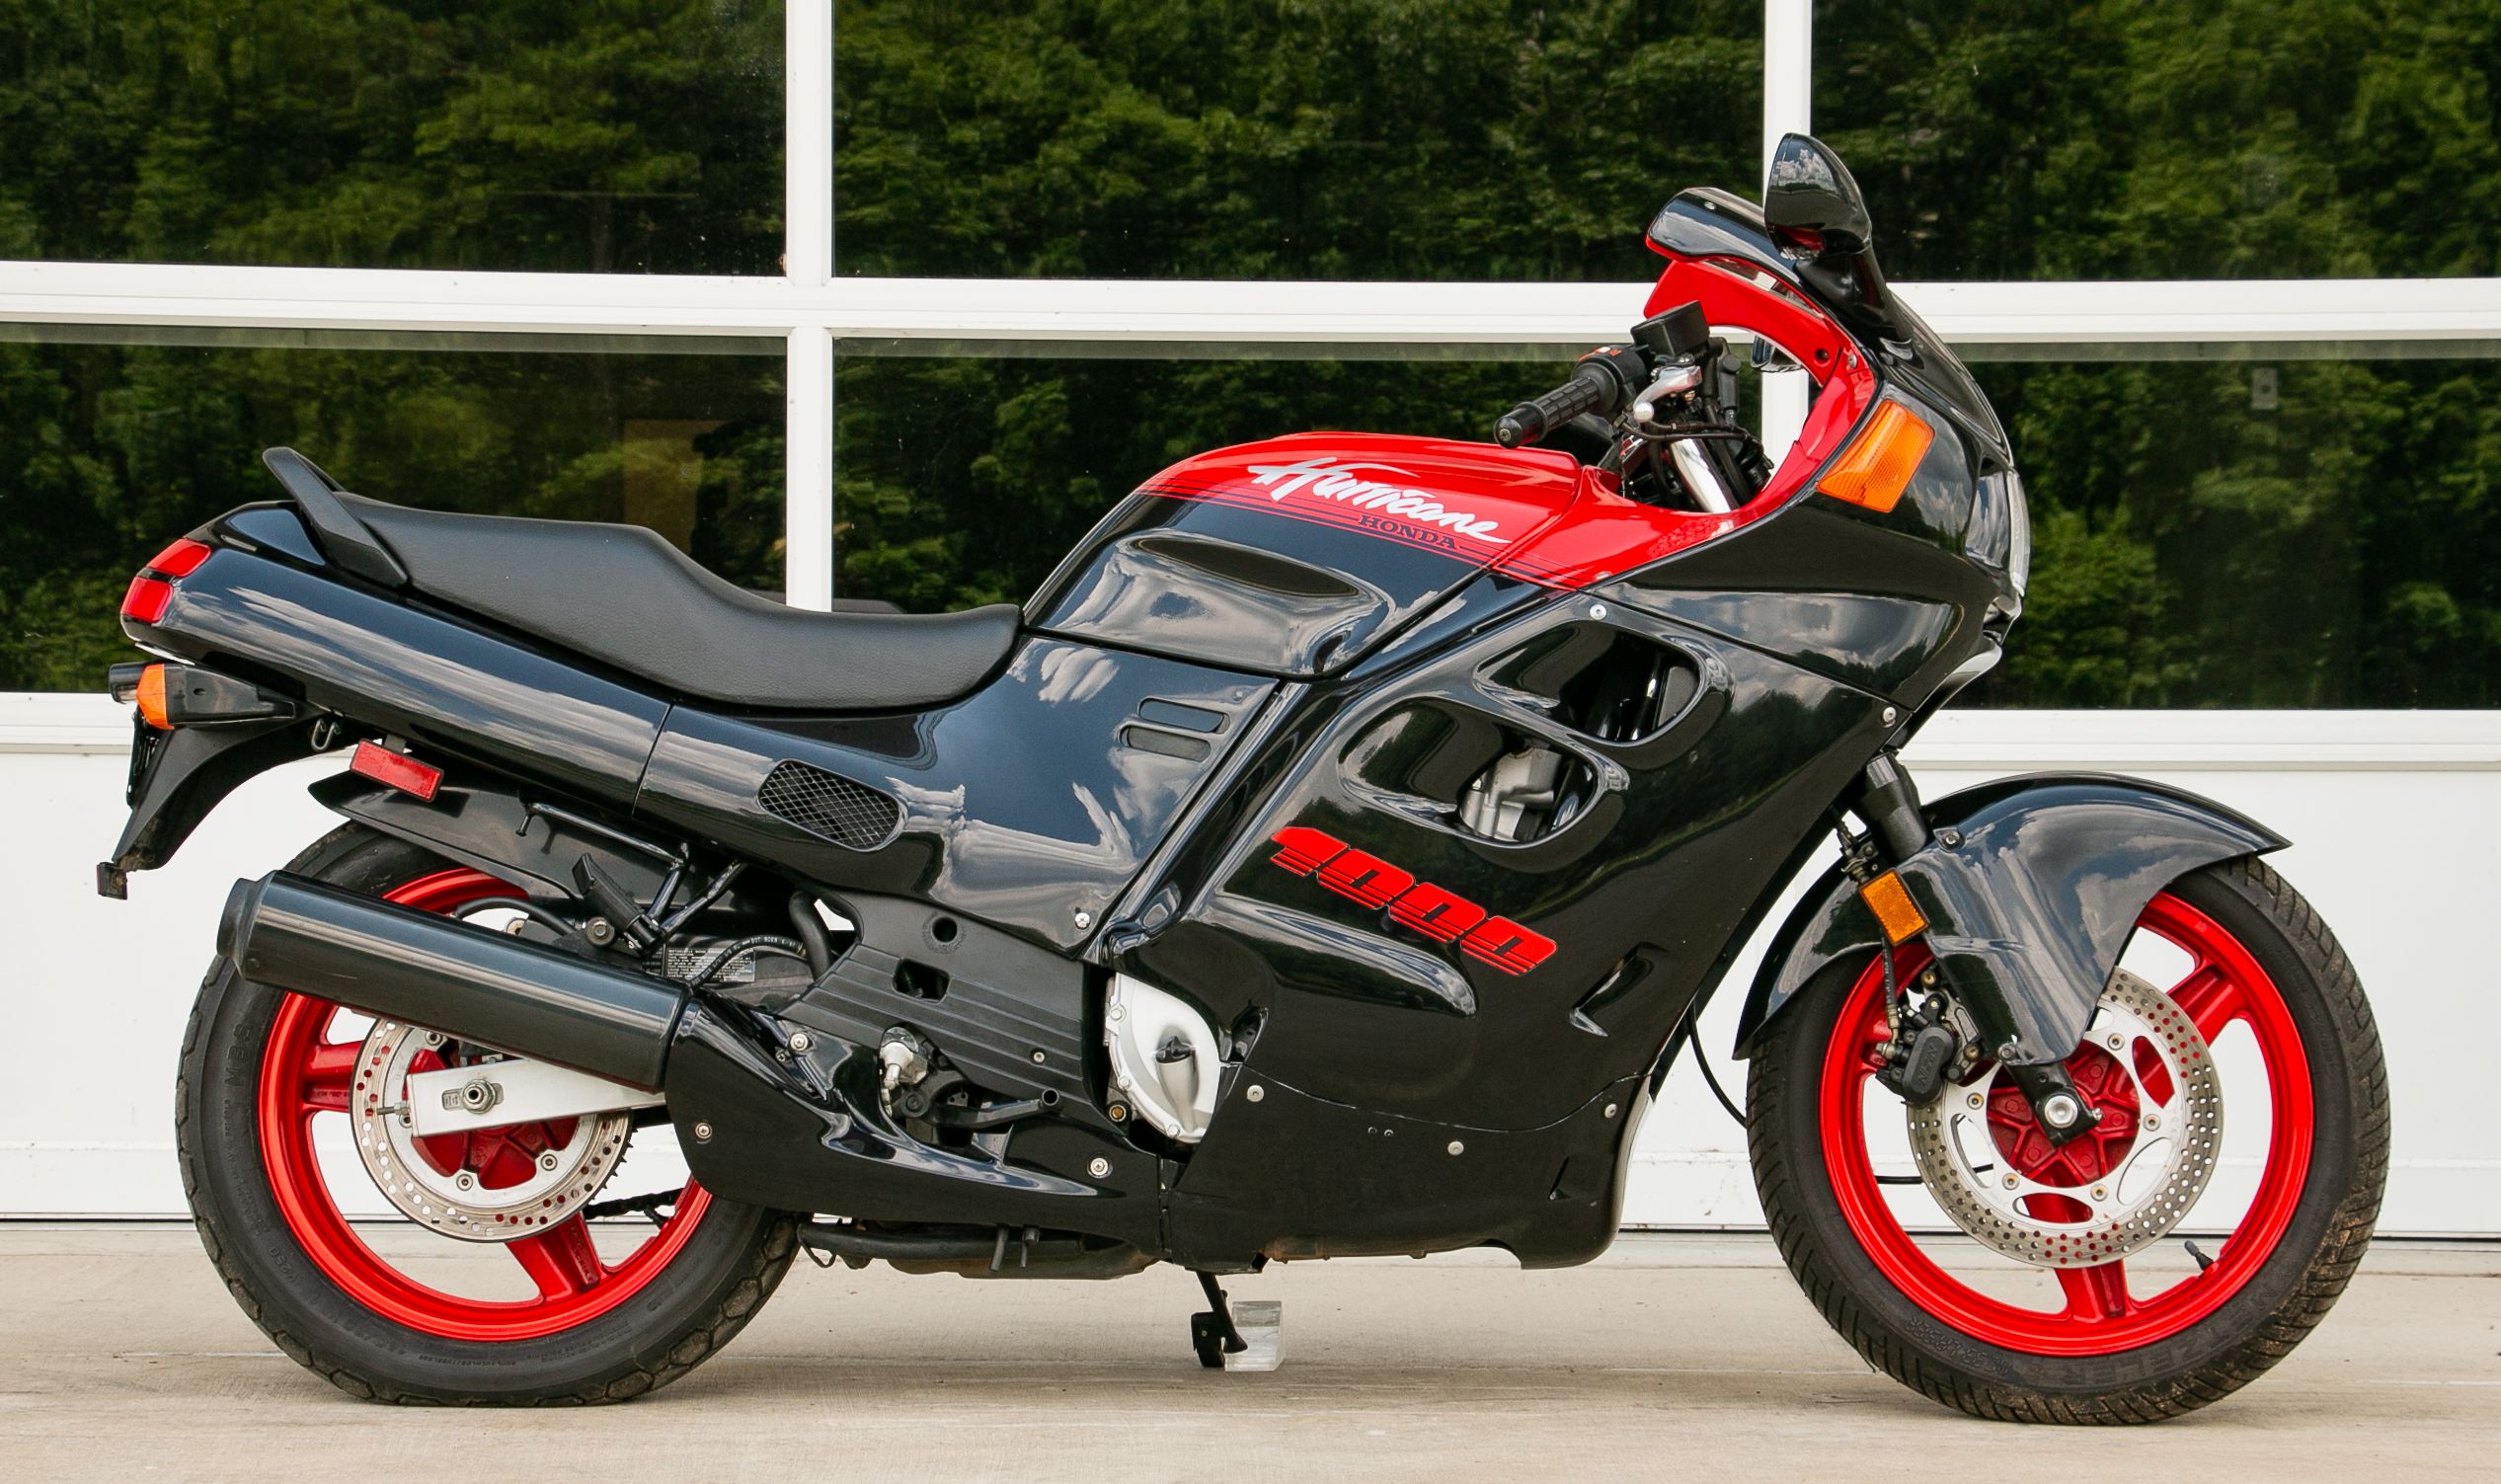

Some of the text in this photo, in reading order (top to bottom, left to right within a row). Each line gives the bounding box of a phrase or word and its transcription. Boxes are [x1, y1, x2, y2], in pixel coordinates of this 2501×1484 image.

[1248, 457, 1512, 543] Hurricane
[1358, 515, 1457, 550] HONDA
[1270, 826, 1557, 976] 1000
